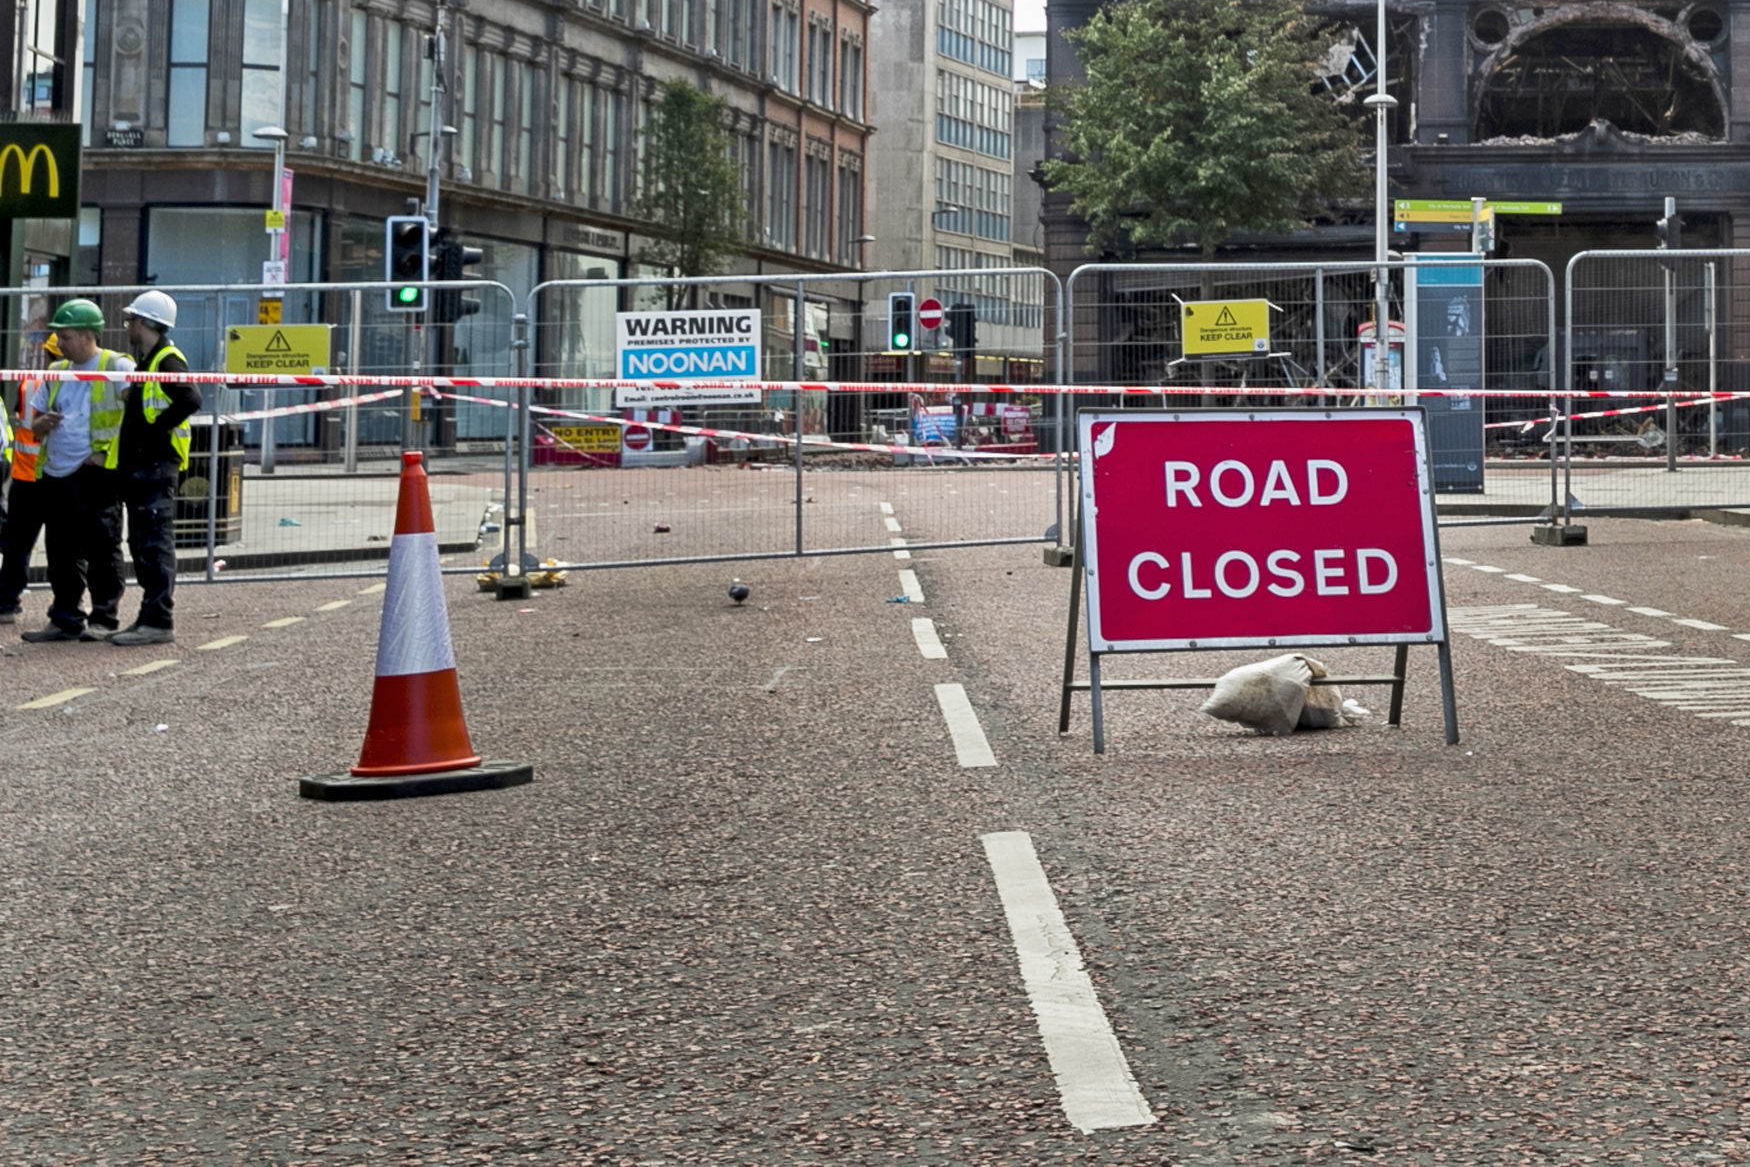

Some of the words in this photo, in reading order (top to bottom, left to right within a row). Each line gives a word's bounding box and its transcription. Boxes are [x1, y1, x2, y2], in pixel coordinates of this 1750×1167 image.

[625, 316, 751, 337] WARNING
[1224, 332, 1253, 341] CLEAR
[679, 337, 734, 345] PROTECTED
[246, 360, 273, 369] KEEP
[275, 359, 309, 368] CLEAR
[629, 350, 747, 375] NOONAN
[1164, 459, 1349, 507] ROAD
[1127, 548, 1399, 601] CLOSED
